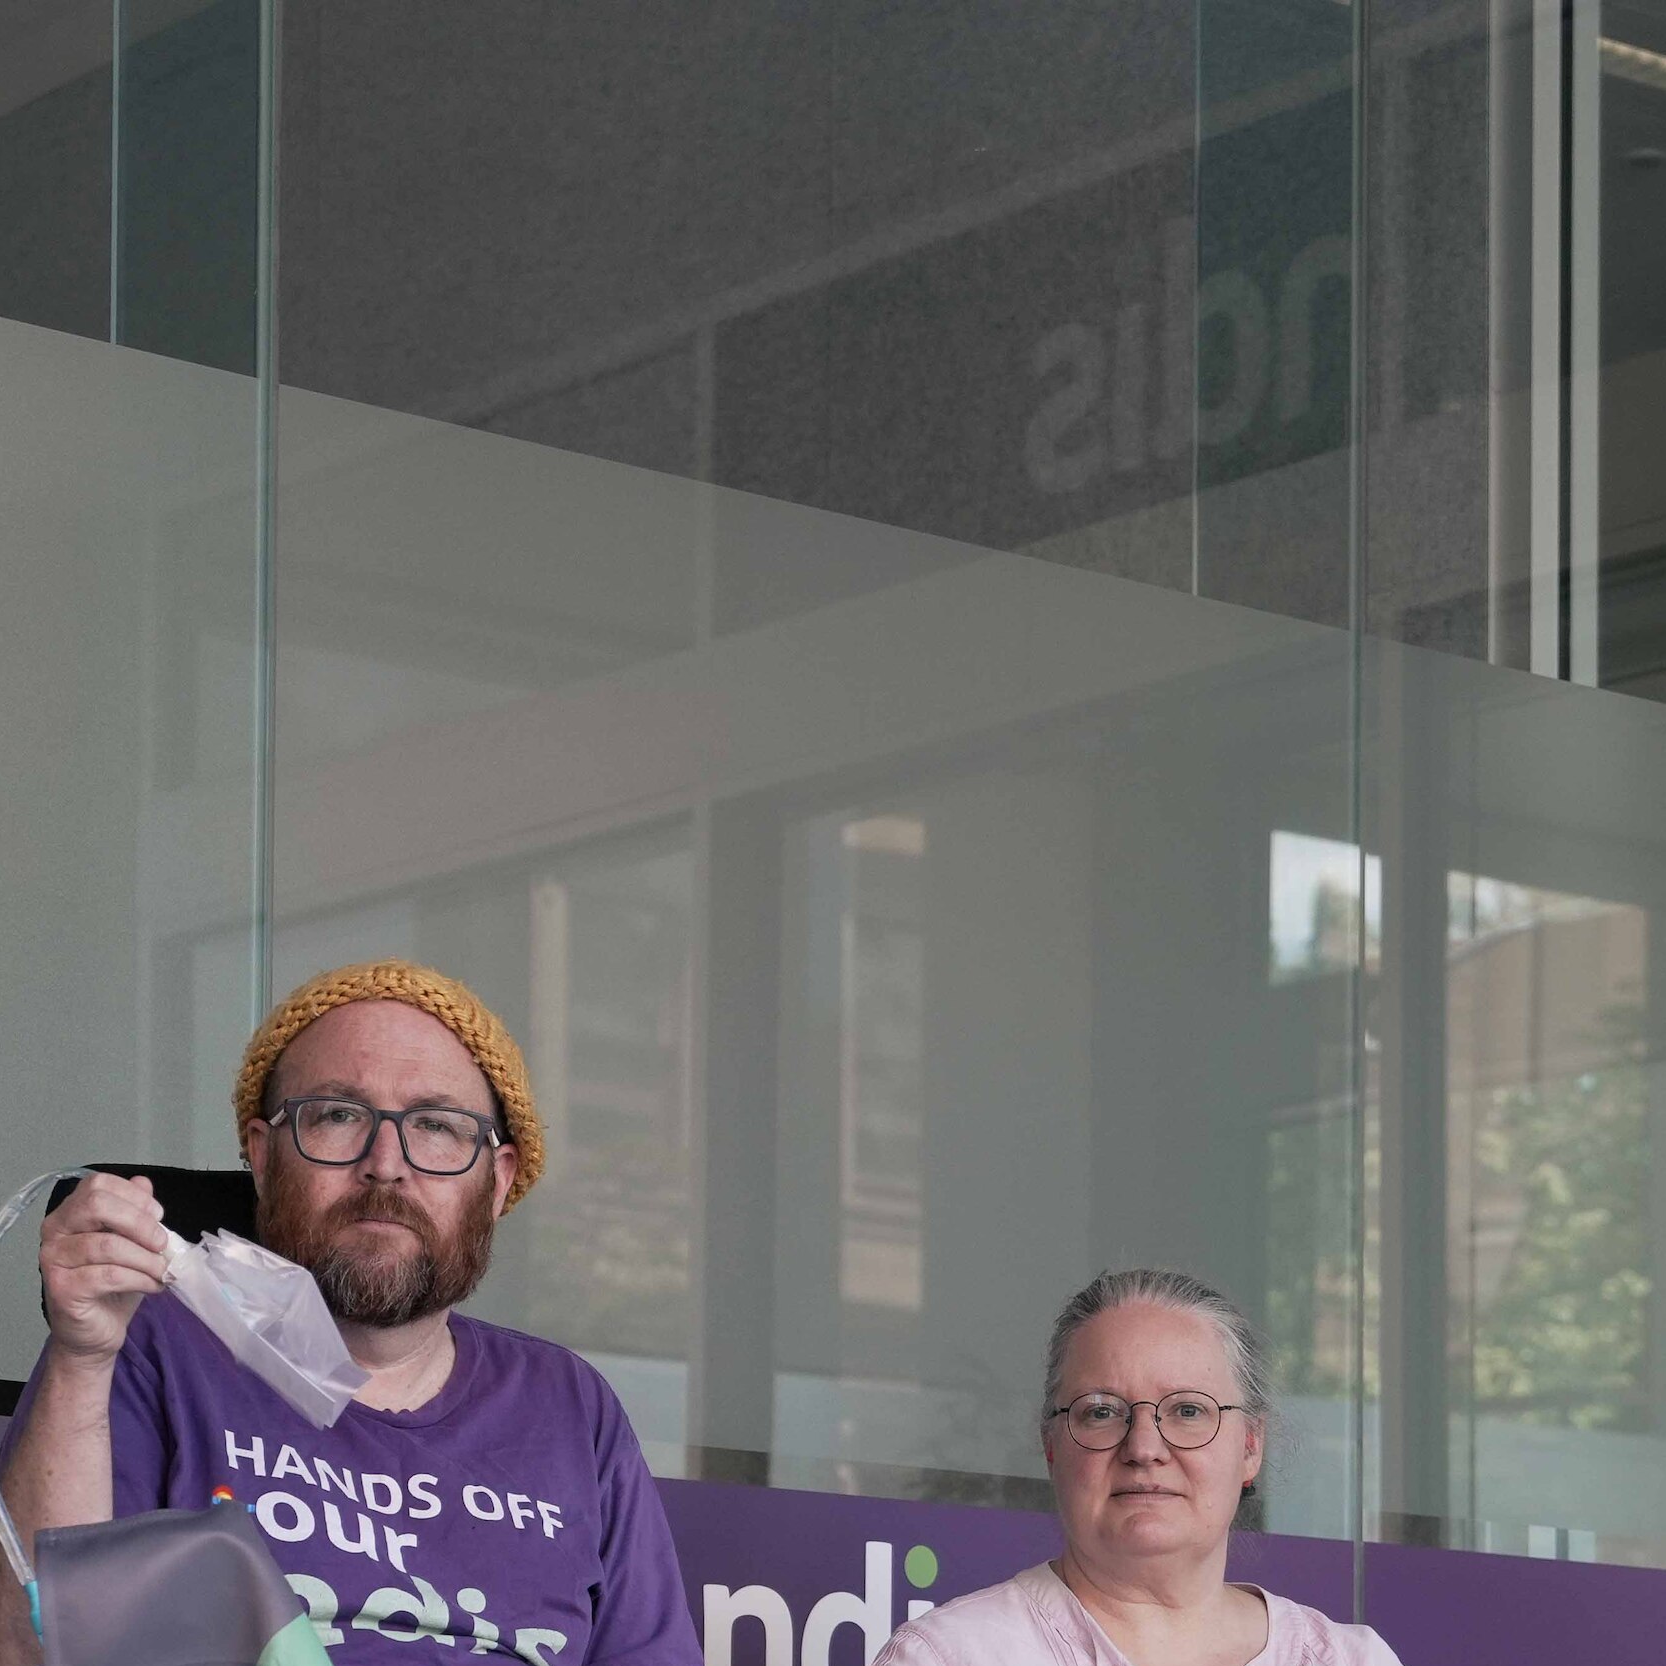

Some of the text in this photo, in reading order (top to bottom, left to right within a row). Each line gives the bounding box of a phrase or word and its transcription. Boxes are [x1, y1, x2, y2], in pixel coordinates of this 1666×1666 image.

[224, 1430, 565, 1540] HANDS OFF
[256, 1491, 418, 1574] our
